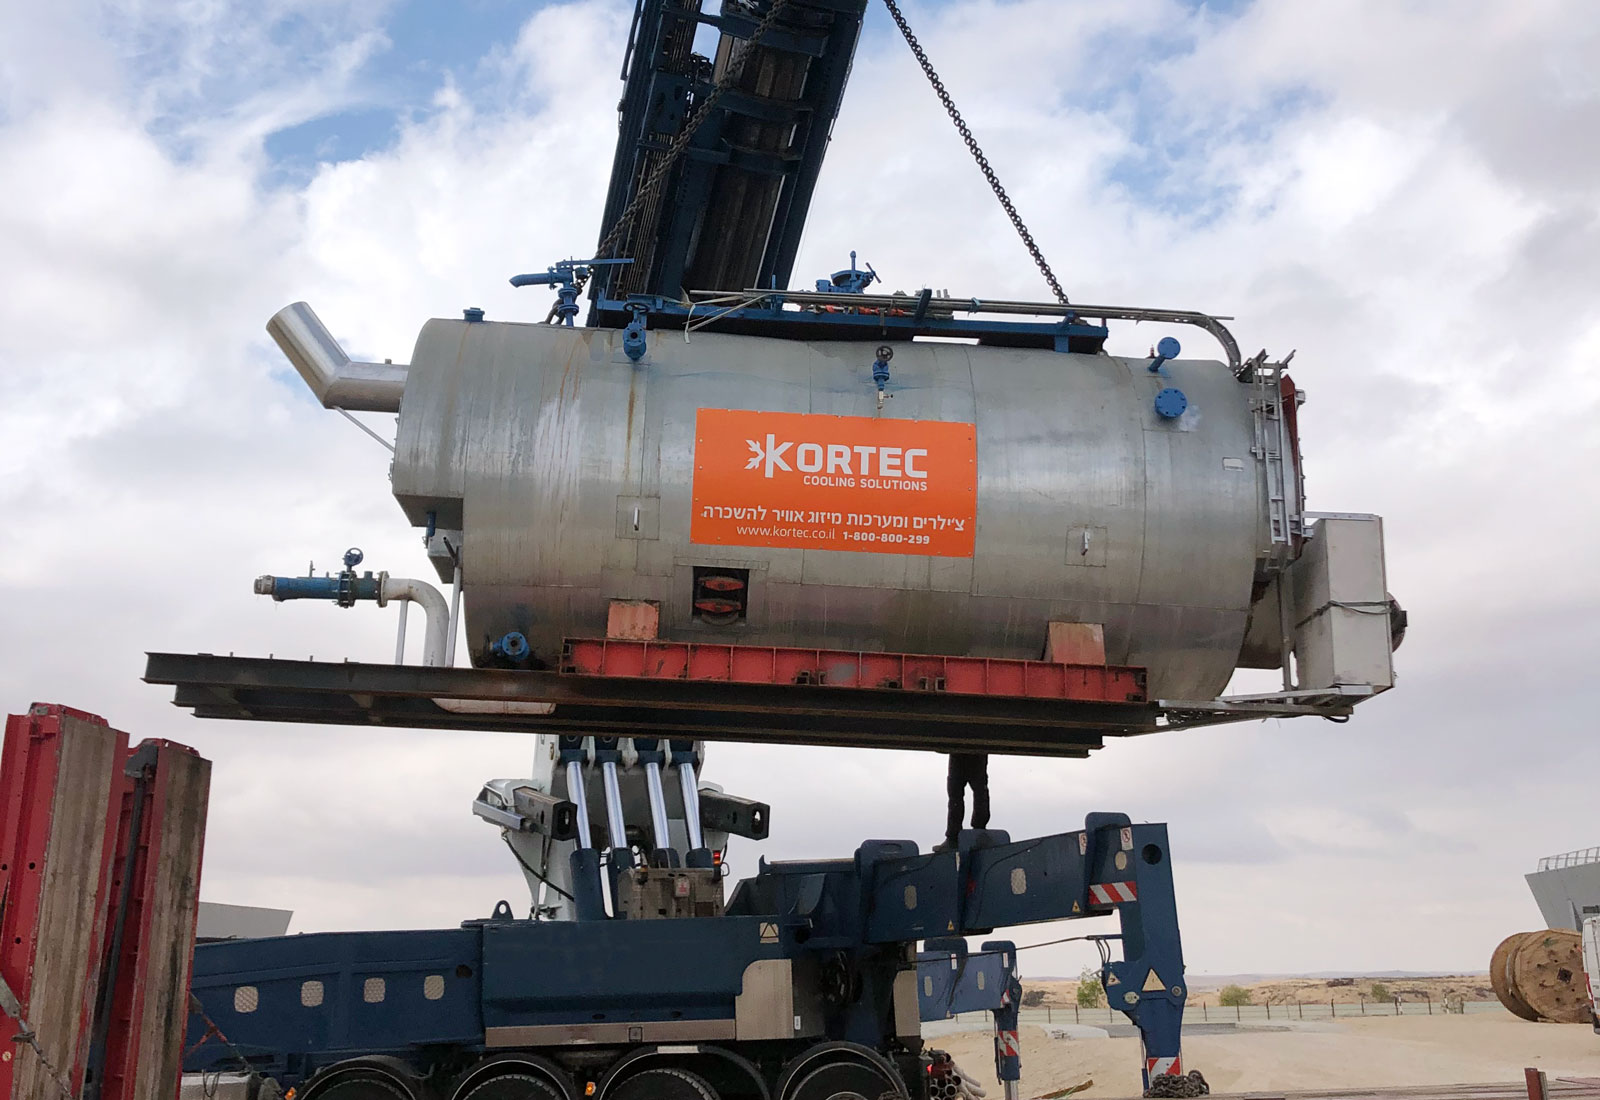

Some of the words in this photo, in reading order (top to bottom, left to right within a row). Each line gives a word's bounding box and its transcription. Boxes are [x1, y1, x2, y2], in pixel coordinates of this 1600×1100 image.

[764, 433, 928, 479] KORTEC
[803, 475, 856, 488] COOLING
[859, 478, 928, 491] SOLUTIONS
[771, 509, 805, 523] אוויר
[807, 511, 842, 525] מיזוג
[846, 513, 909, 529] ומערכות
[736, 525, 835, 540] www.kortec.co.il
[842, 531, 930, 545] 1-800-800-299
